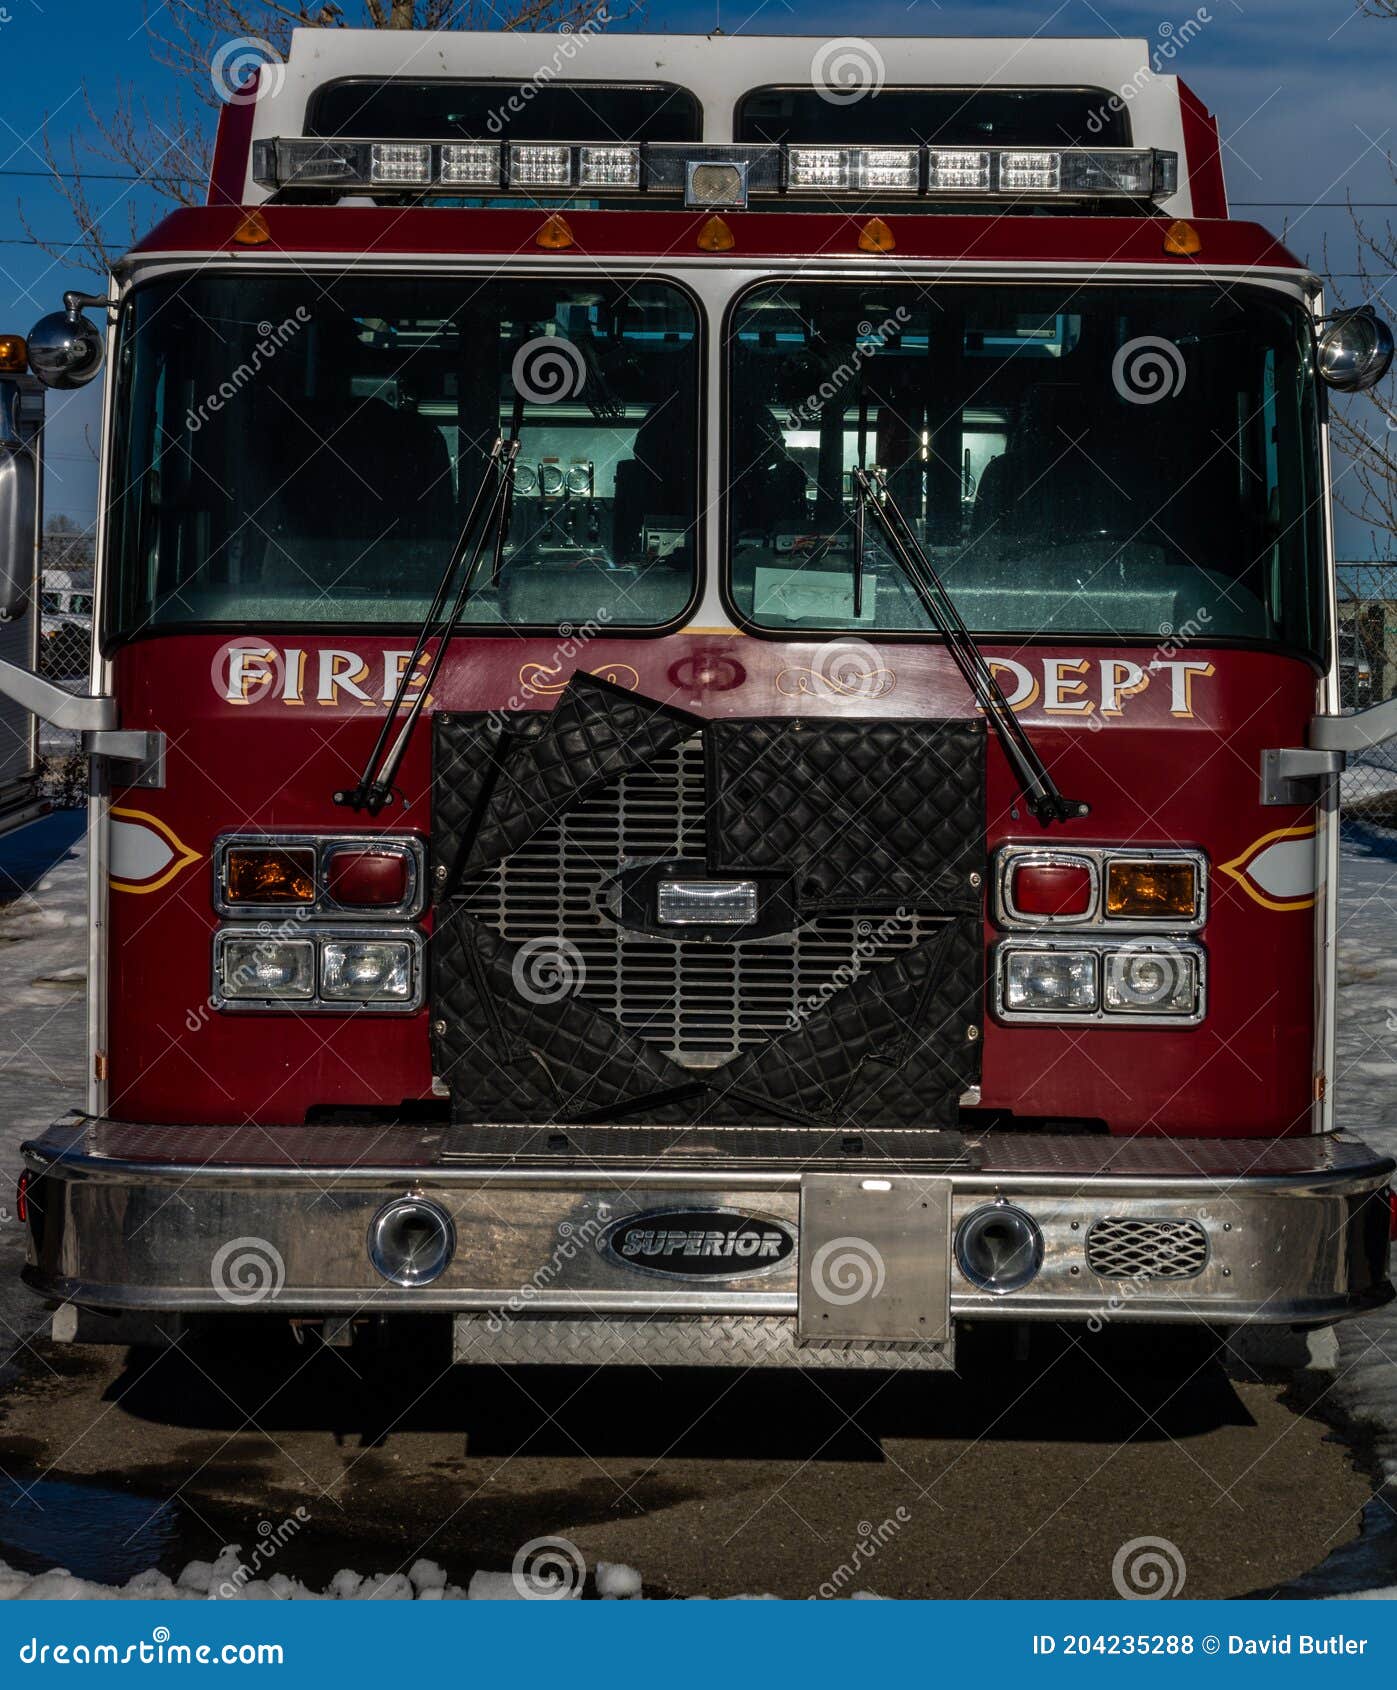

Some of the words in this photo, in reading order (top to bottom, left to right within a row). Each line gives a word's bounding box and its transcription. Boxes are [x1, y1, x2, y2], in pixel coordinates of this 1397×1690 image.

[226, 648, 433, 706] FIRE
[975, 656, 1216, 718] DEPT
[621, 1229, 783, 1257] SUPERIOR
